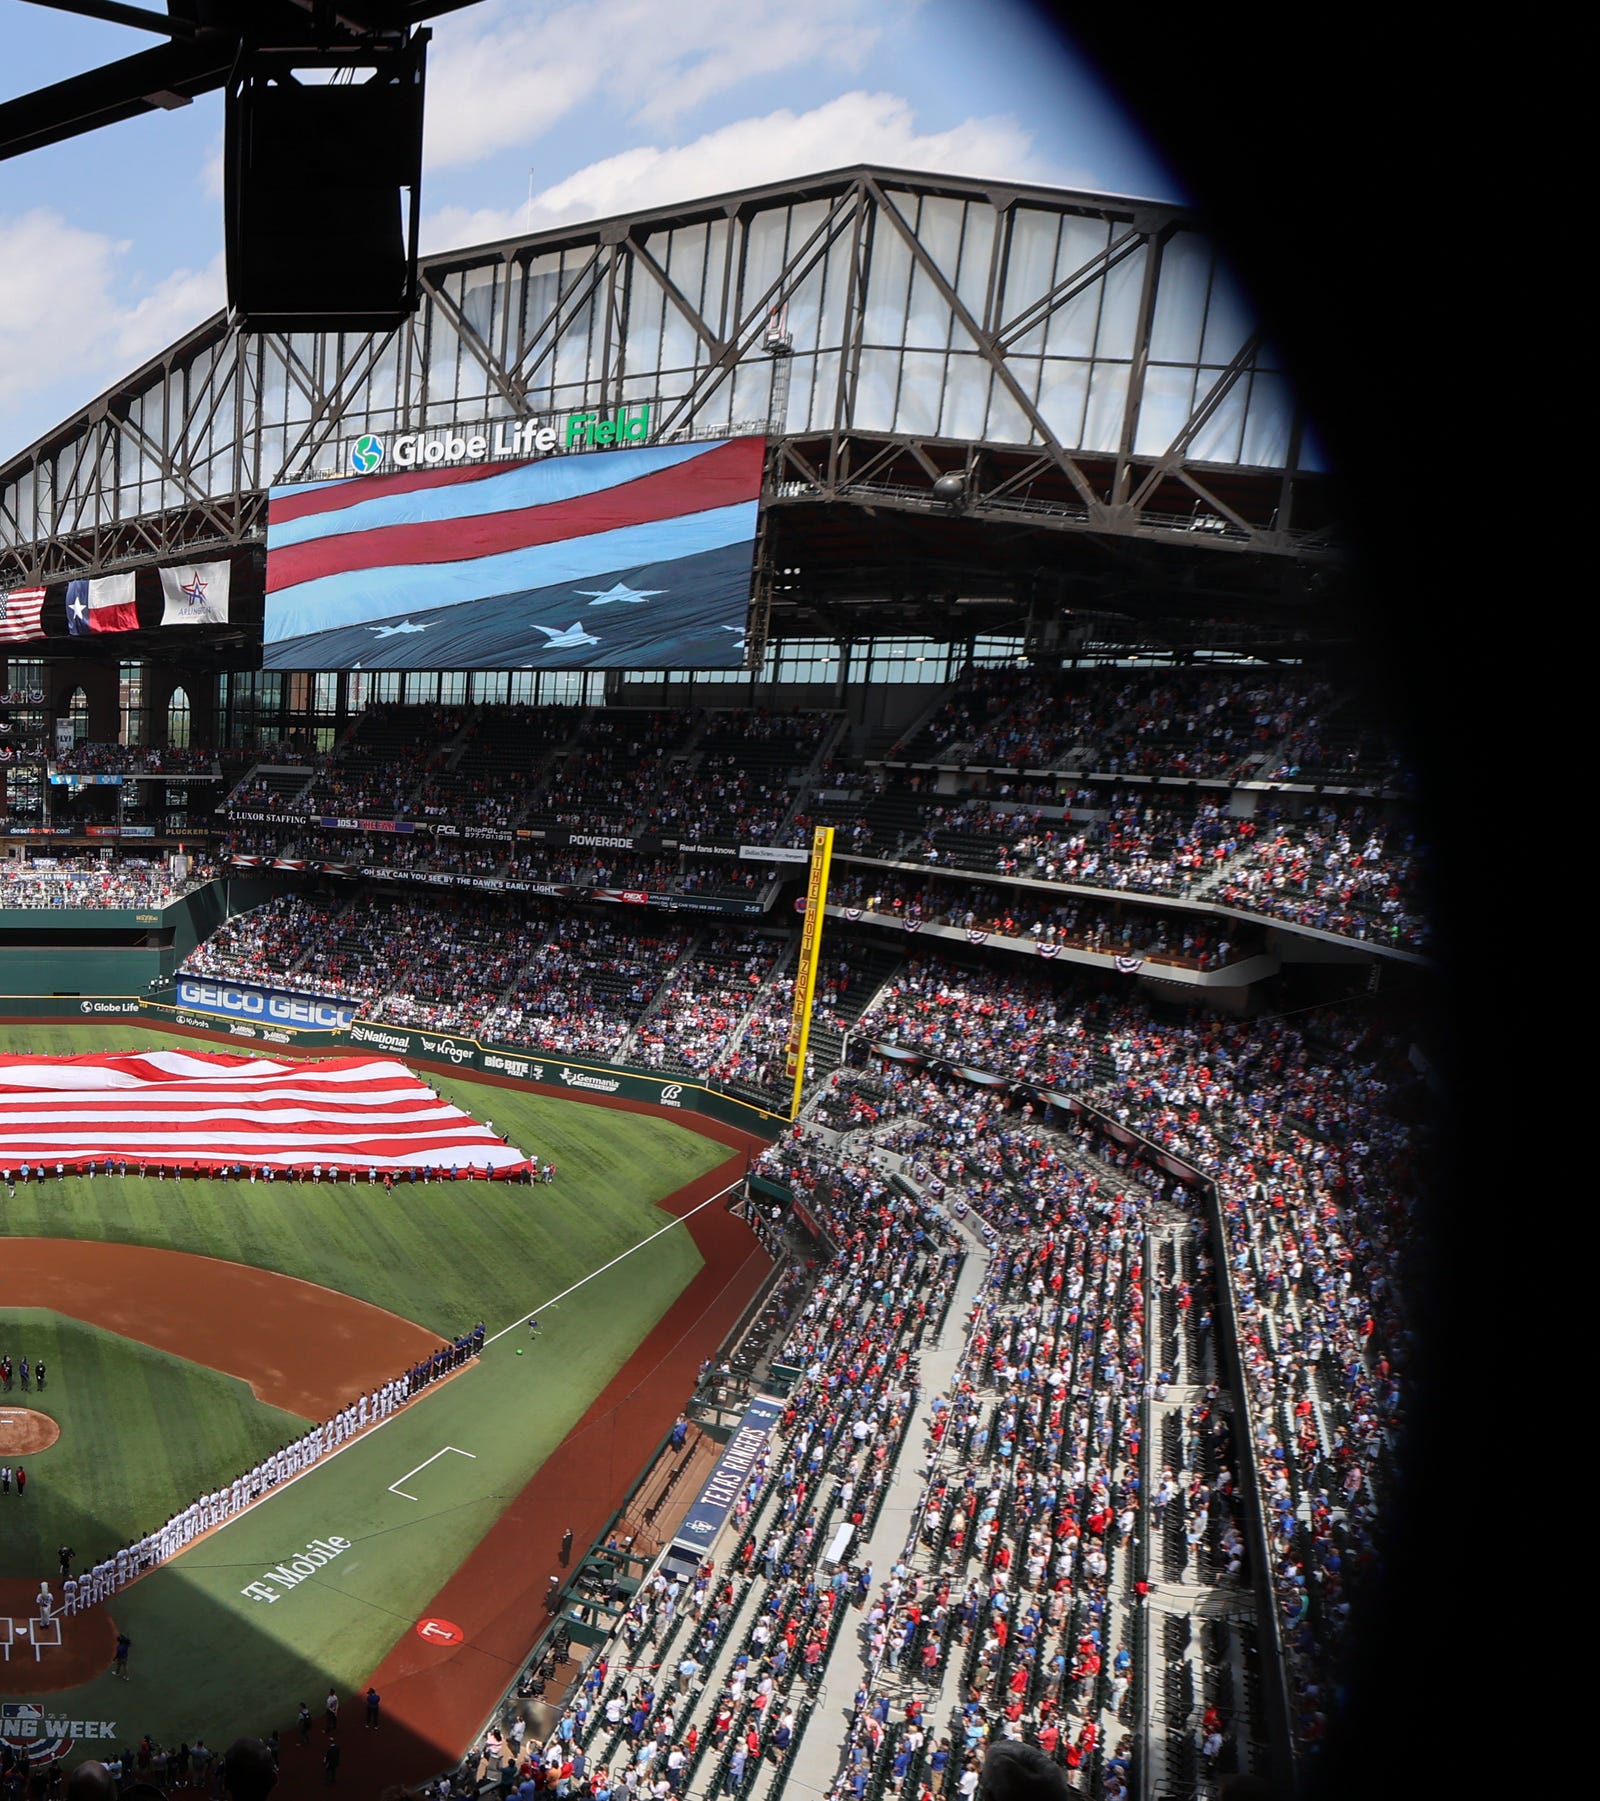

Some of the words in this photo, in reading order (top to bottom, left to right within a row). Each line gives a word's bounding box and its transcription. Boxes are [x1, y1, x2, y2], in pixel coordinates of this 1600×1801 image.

[392, 431, 487, 466] Globe
[494, 418, 557, 456] Life
[566, 404, 650, 448] Field
[236, 811, 265, 821] LUXOR
[266, 813, 307, 825] STAFFING
[569, 834, 633, 849] POWERADE
[679, 843, 697, 852] Real
[697, 845, 713, 853] fans
[377, 870, 392, 878] SAY
[410, 873, 427, 881] YOU
[505, 882, 531, 891] EARLY
[532, 885, 555, 894] LIGHT
[810, 857, 822, 898] THE
[804, 910, 816, 950] HOT
[796, 960, 809, 1015] ZONE
[94, 1002, 121, 1012] Globe
[122, 1002, 139, 1012] Life
[181, 981, 264, 1014] GEICO
[364, 1030, 409, 1047] National
[378, 1043, 389, 1051] Car
[437, 1039, 474, 1063] Kroger
[504, 1060, 529, 1074] BITE
[576, 1073, 620, 1088] Germania
[660, 1098, 681, 1108] SPORTS
[701, 1470, 742, 1508] TEXAS
[722, 1426, 766, 1473] RANGERS
[421, 1621, 456, 1640] T
[45, 1720, 117, 1739] WEEK
